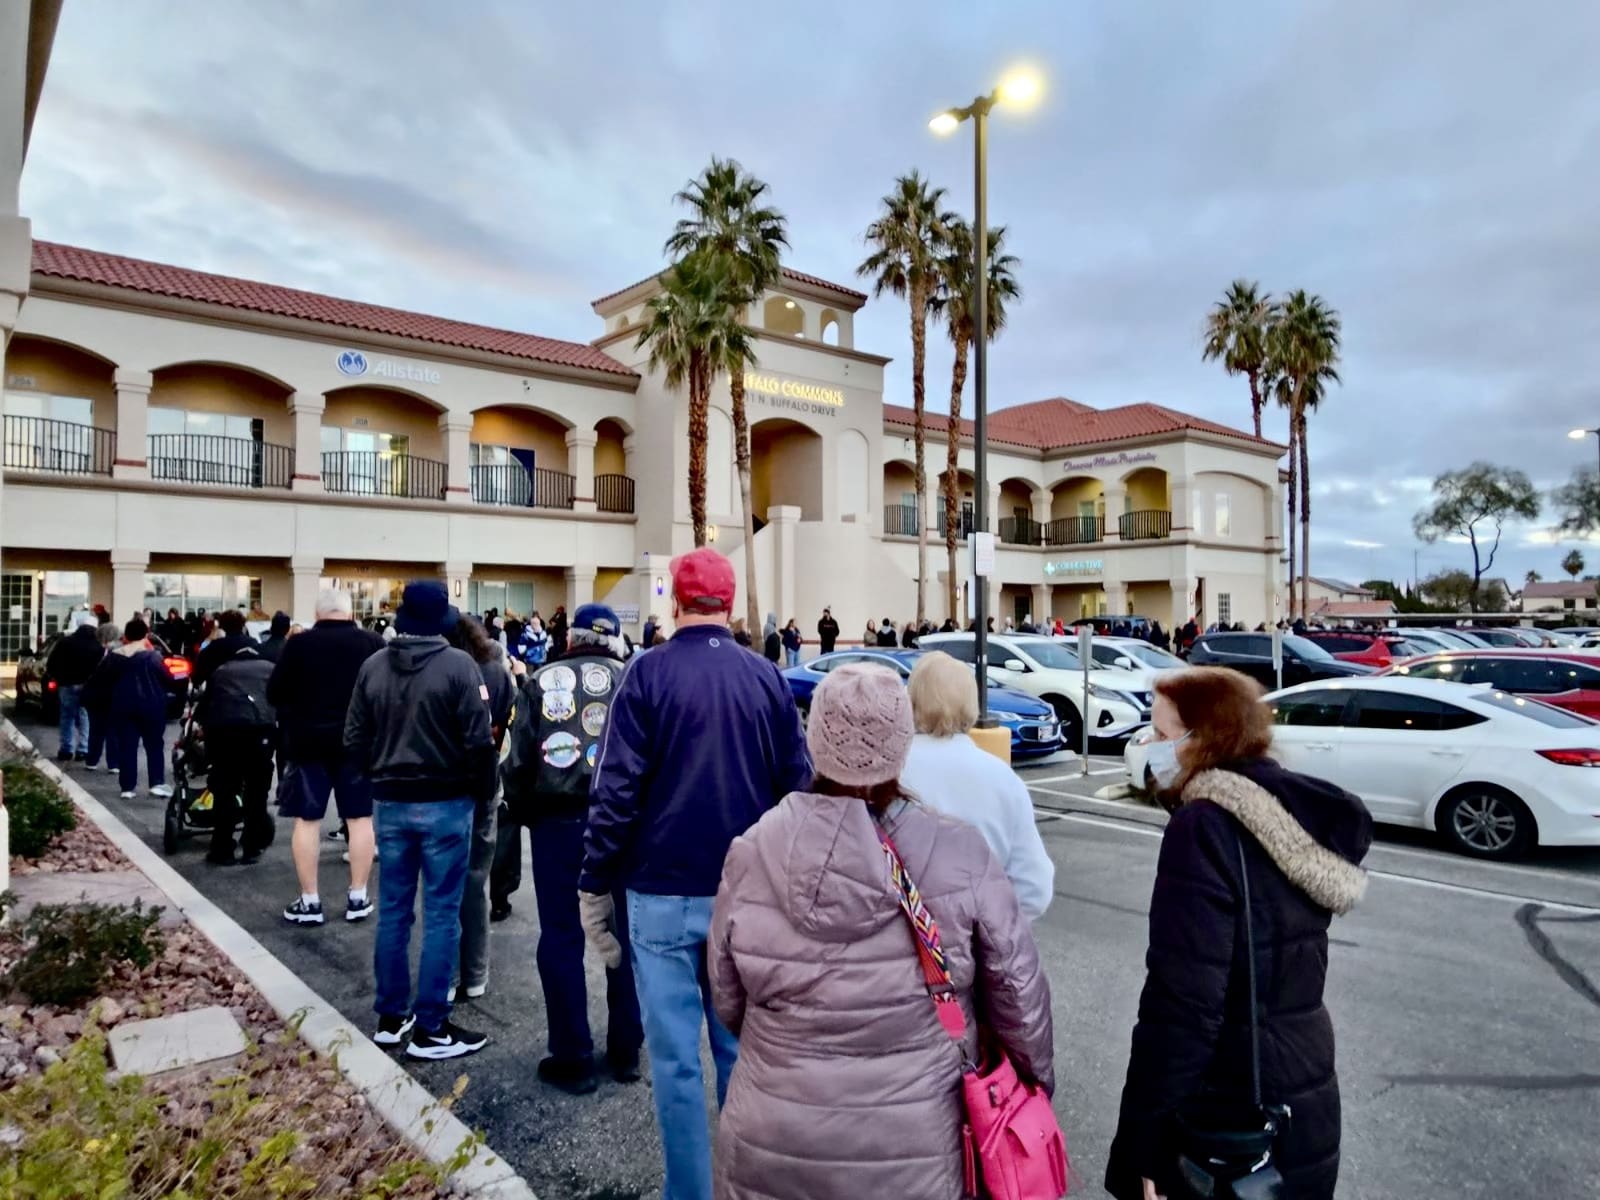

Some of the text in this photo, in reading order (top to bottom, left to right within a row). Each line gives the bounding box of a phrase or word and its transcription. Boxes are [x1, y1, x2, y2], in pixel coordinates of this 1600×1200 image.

[373, 360, 440, 384] Allstate
[728, 373, 844, 407] FFALO COMMONS
[770, 396, 809, 412] BUFFALO
[810, 404, 836, 417] DRIVE
